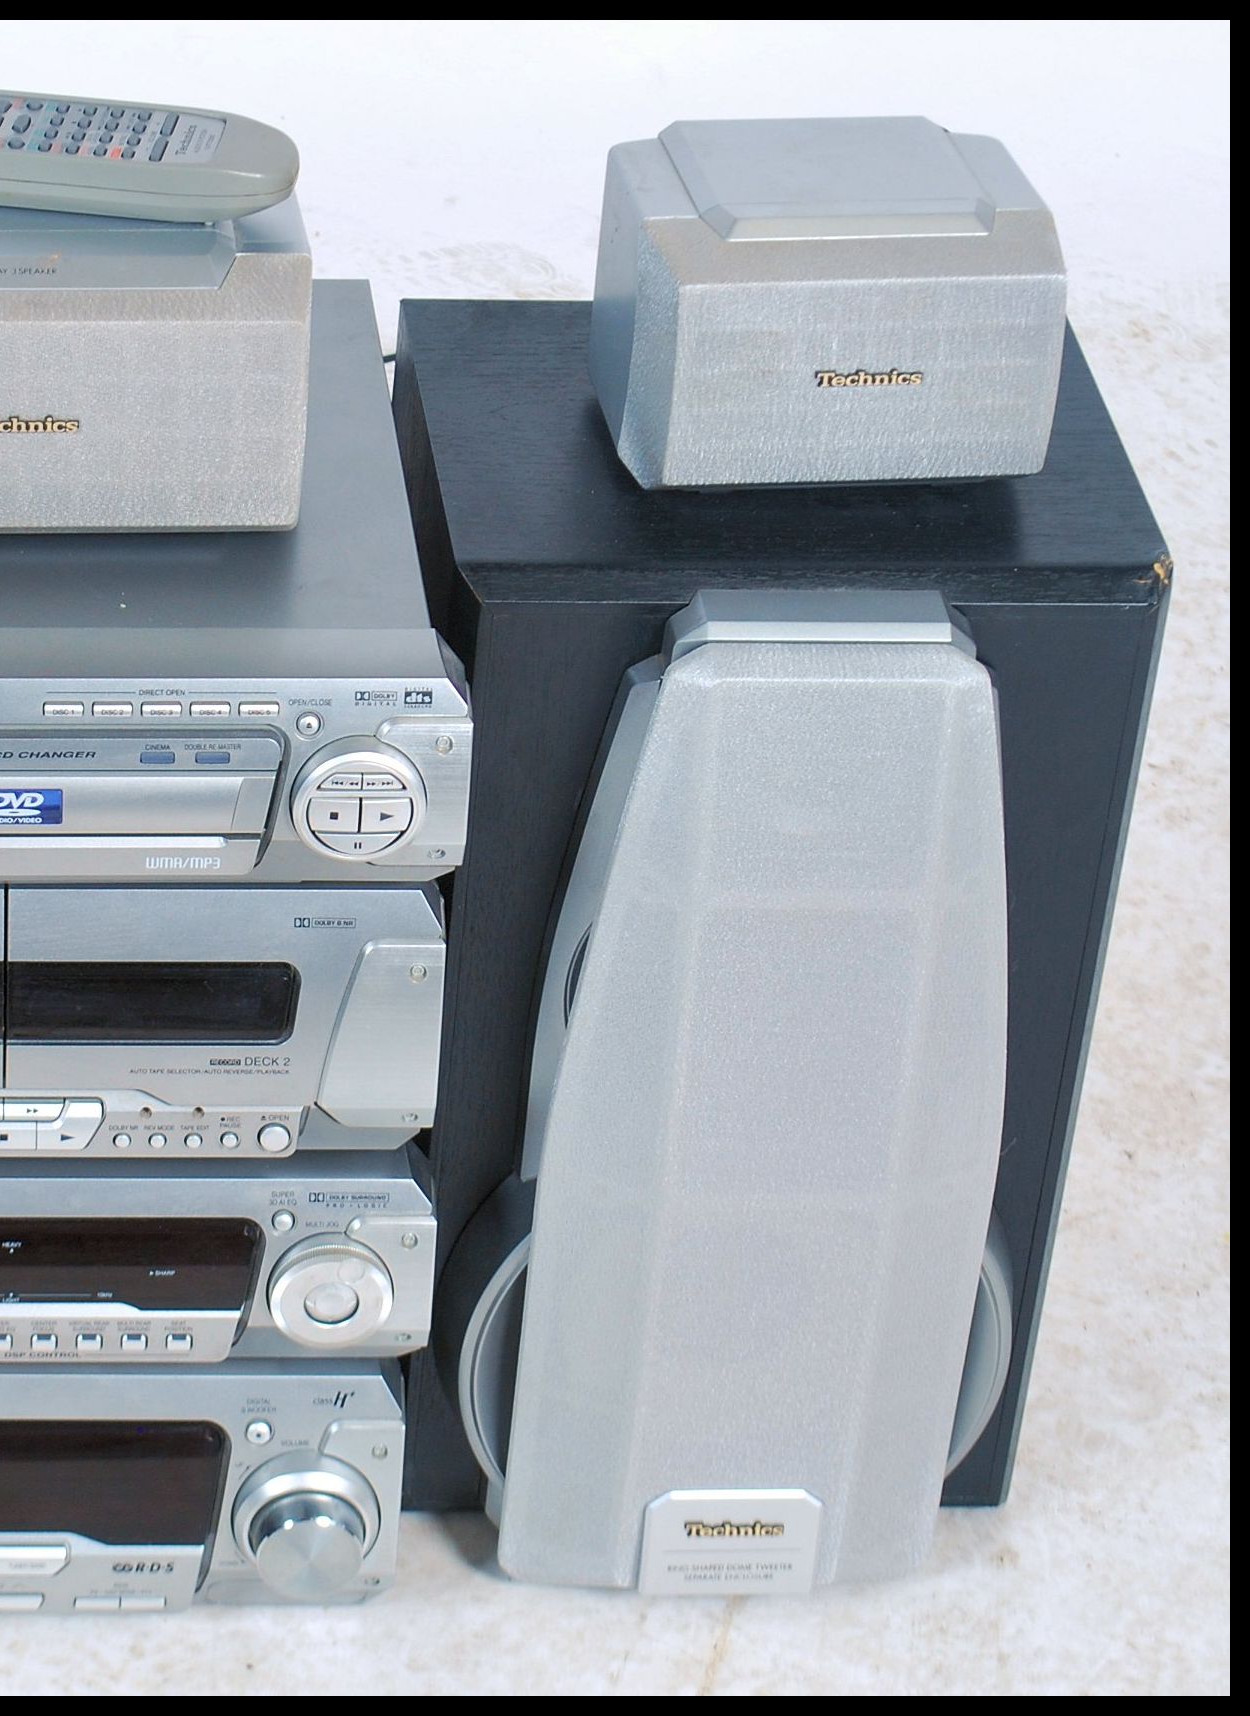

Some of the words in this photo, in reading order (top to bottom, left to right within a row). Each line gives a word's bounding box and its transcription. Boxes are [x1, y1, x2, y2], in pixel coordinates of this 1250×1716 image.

[815, 368, 923, 388] Technics
[138, 689, 164, 697] DIRECT
[165, 689, 186, 697] OPEN
[289, 699, 332, 707] OPEN/CLOSE
[145, 743, 171, 751] CINEMA
[18, 751, 97, 759] CHANGER
[145, 856, 221, 869] WMA/MP3
[244, 1056, 279, 1067] DECK
[283, 1056, 291, 1067] 2
[271, 1190, 295, 1198] SUPER
[684, 1520, 784, 1537] Technics
